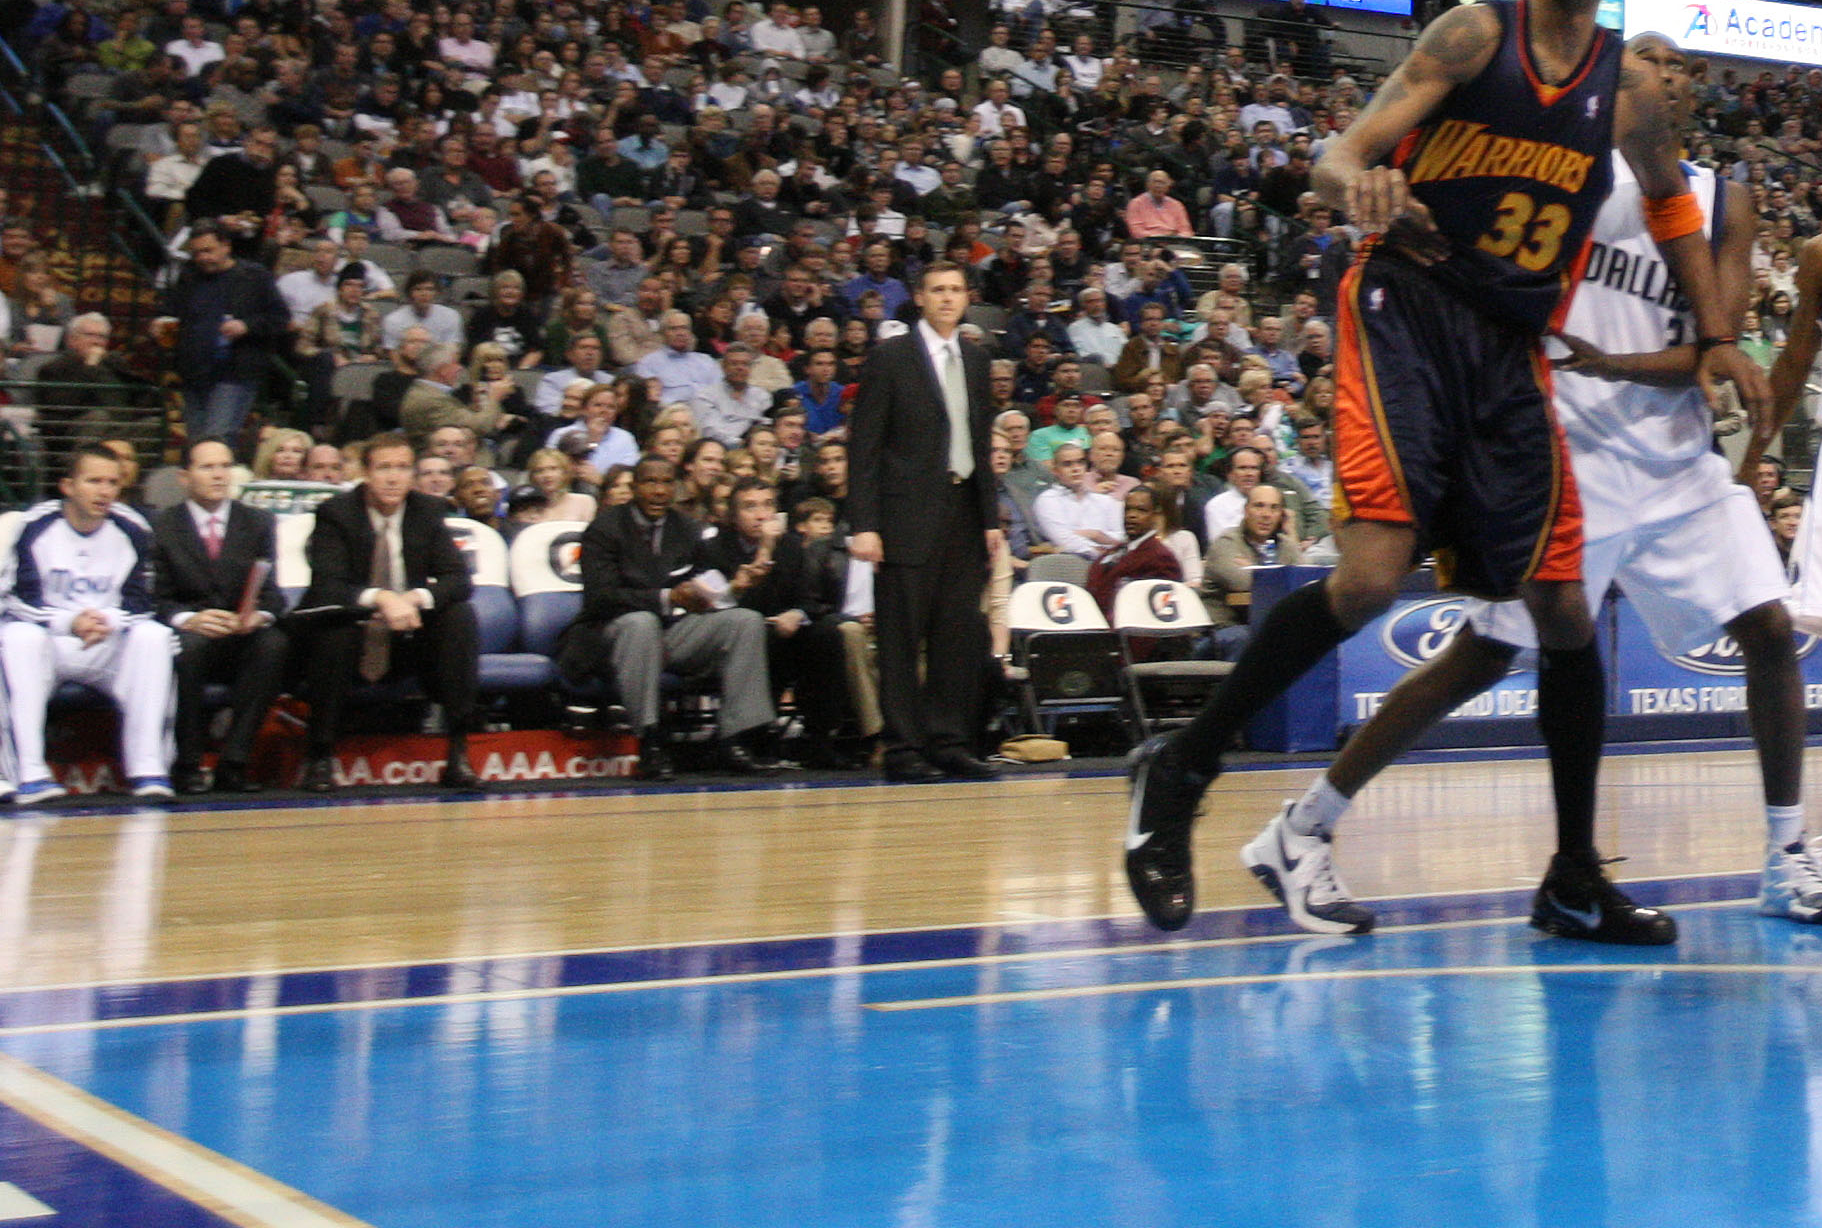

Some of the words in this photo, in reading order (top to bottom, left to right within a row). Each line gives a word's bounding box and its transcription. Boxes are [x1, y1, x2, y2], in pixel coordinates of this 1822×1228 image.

[1409, 119, 1596, 194] WARRIORS
[1475, 191, 1572, 272] 33
[1585, 240, 1692, 313] DALLA
[1628, 686, 1699, 714] TEXAS
